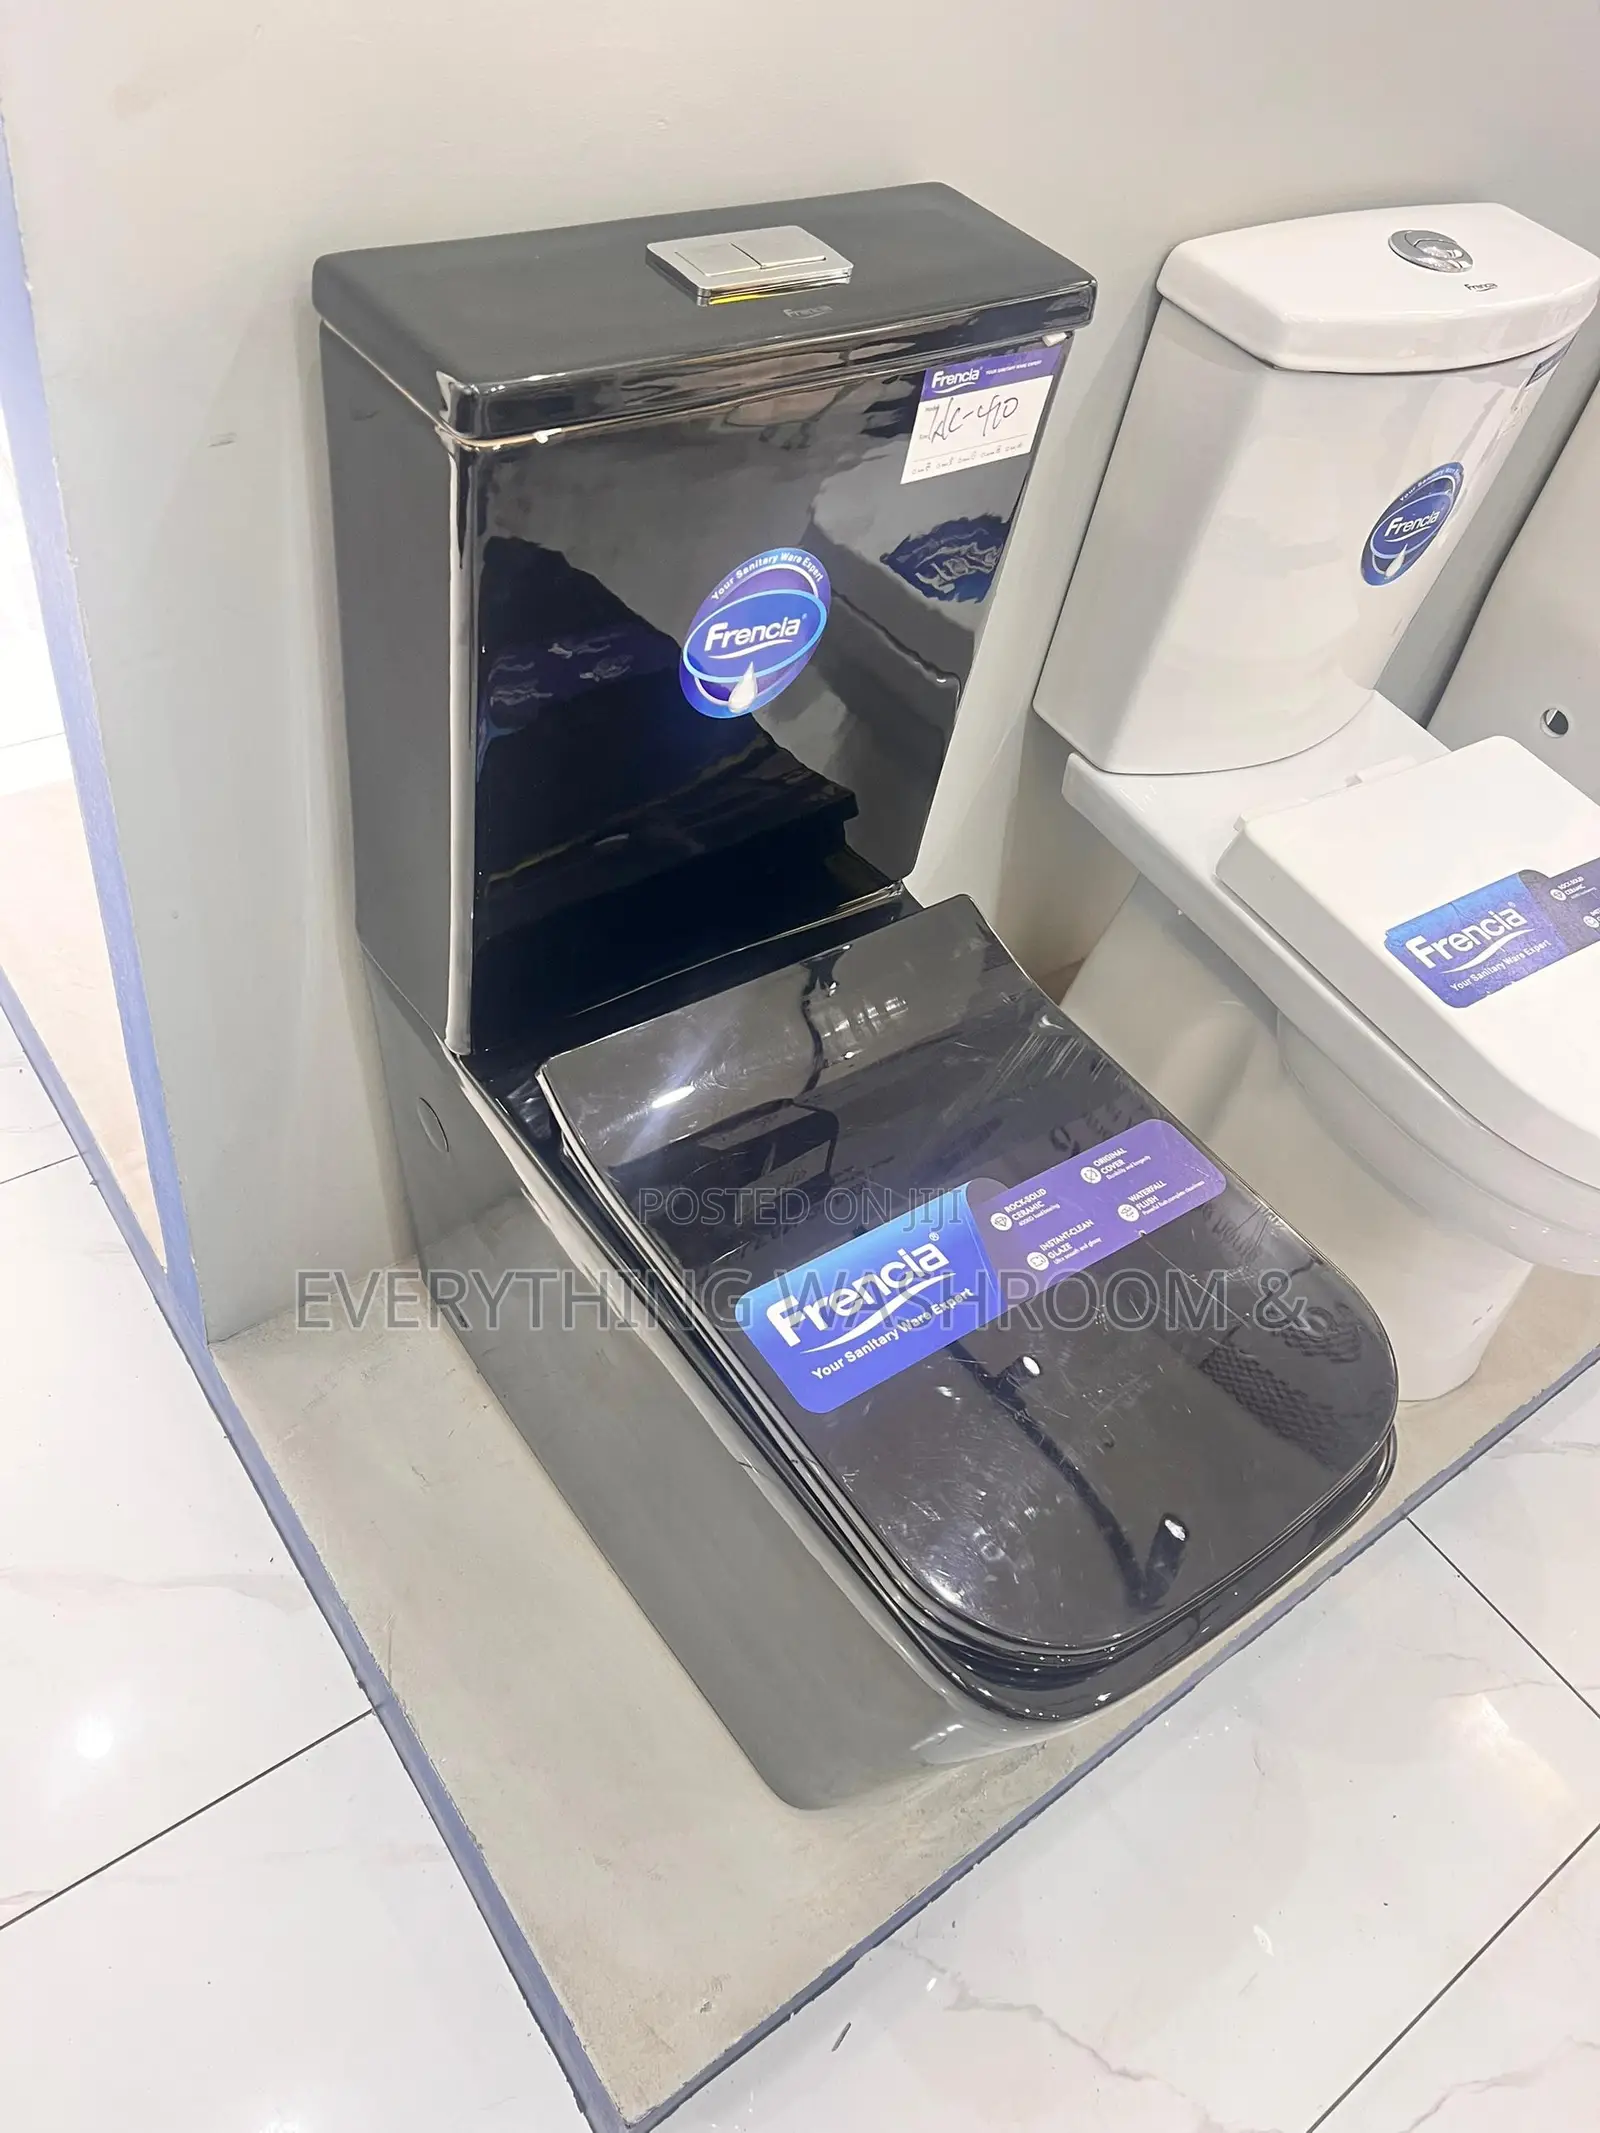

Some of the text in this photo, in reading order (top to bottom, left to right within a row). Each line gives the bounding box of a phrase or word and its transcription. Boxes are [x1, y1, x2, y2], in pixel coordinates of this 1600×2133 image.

[931, 367, 981, 389] Frencia
[1384, 510, 1440, 537] Frencia
[711, 551, 824, 601] Your Sanitary Ware Expert
[704, 616, 801, 652] Frencia
[1405, 908, 1528, 969] Frencia
[1450, 939, 1552, 992] Your Sanitary Ware Expert
[1093, 1147, 1128, 1167] ORIGINAL
[1100, 1158, 1126, 1174] COVER
[1003, 1188, 1047, 1213] ROCK-SOLID
[1127, 1180, 1168, 1202] WATERFALL
[1135, 1194, 1160, 1210] FLUSH
[1011, 1200, 1046, 1221] CERAMIC
[1039, 1218, 1095, 1251] INSTANT-CLEAN
[1047, 1242, 1073, 1260] GLAZE
[767, 1243, 949, 1347] Frencia
[811, 1287, 975, 1380] Your Sanitary Ware Expert
